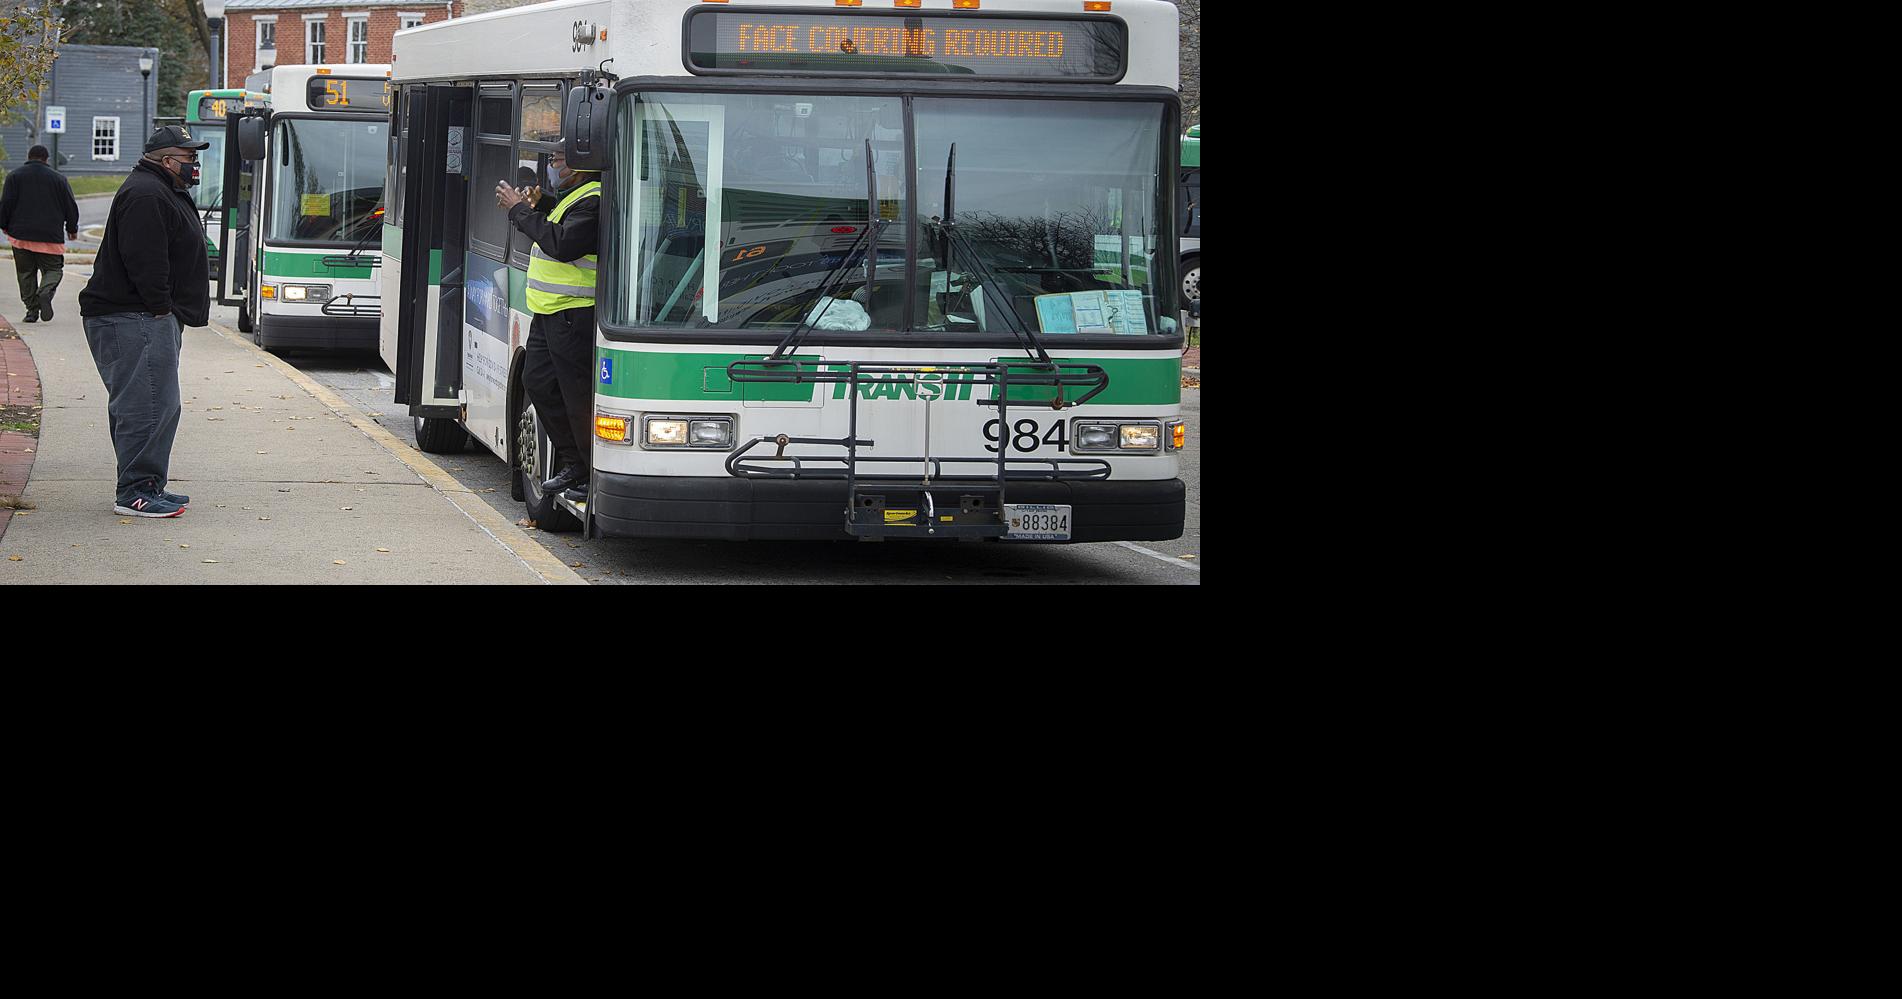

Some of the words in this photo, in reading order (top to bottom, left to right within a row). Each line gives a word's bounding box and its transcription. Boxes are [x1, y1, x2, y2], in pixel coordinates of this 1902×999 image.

[739, 24, 800, 51] FACE
[809, 26, 935, 55] COVERING
[945, 28, 1063, 57] REQUIRED
[325, 80, 350, 106] 51
[827, 362, 986, 401] TRANSIT
[982, 418, 1070, 453] 984
[1022, 514, 1067, 531] 88384
